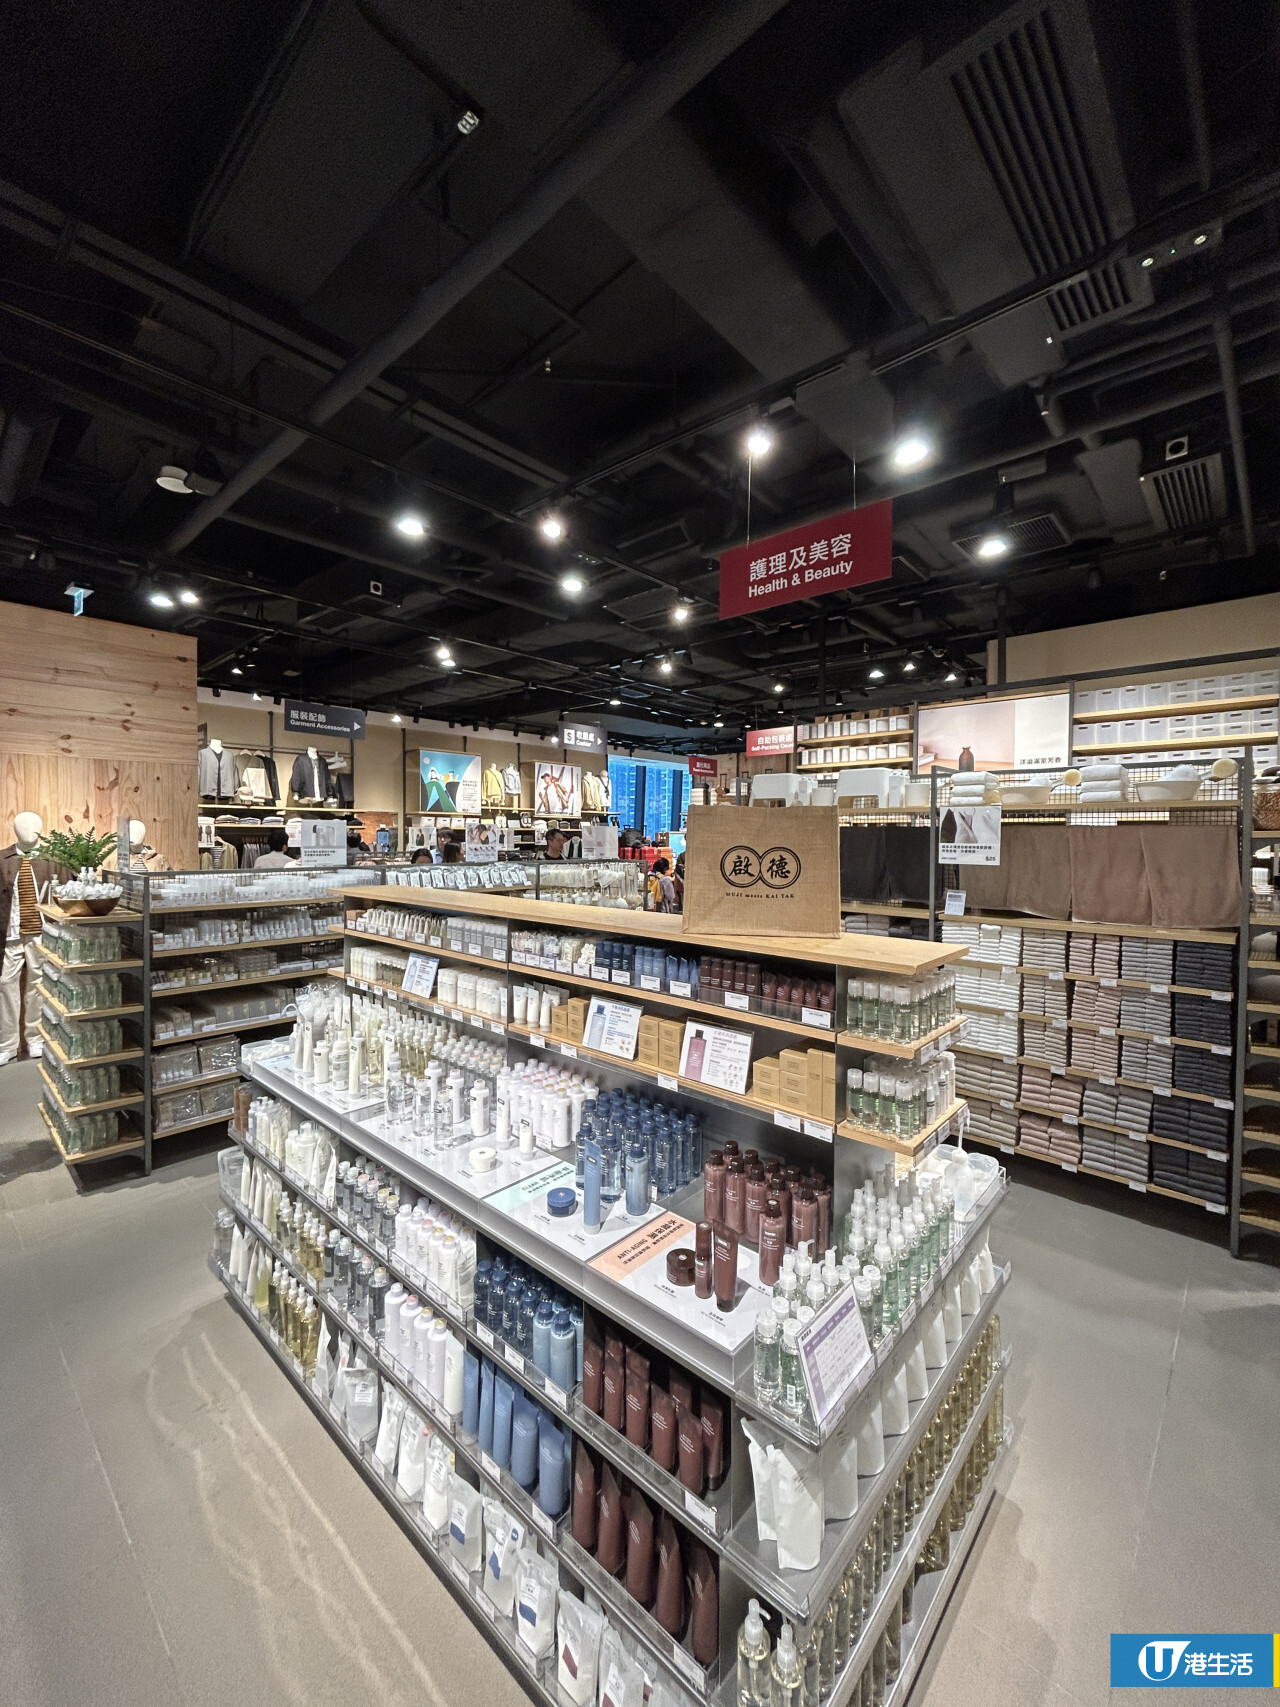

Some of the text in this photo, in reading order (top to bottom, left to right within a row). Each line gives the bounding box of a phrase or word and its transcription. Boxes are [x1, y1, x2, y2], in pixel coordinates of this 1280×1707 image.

[749, 533, 852, 583] 護理及美容
[748, 560, 854, 598] Health & Beauty
[290, 709, 327, 723] 服裝配飾
[289, 719, 351, 732] Garment Accessories
[751, 743, 780, 752] Self-Packing
[617, 1238, 649, 1260] ANTI-AGING
